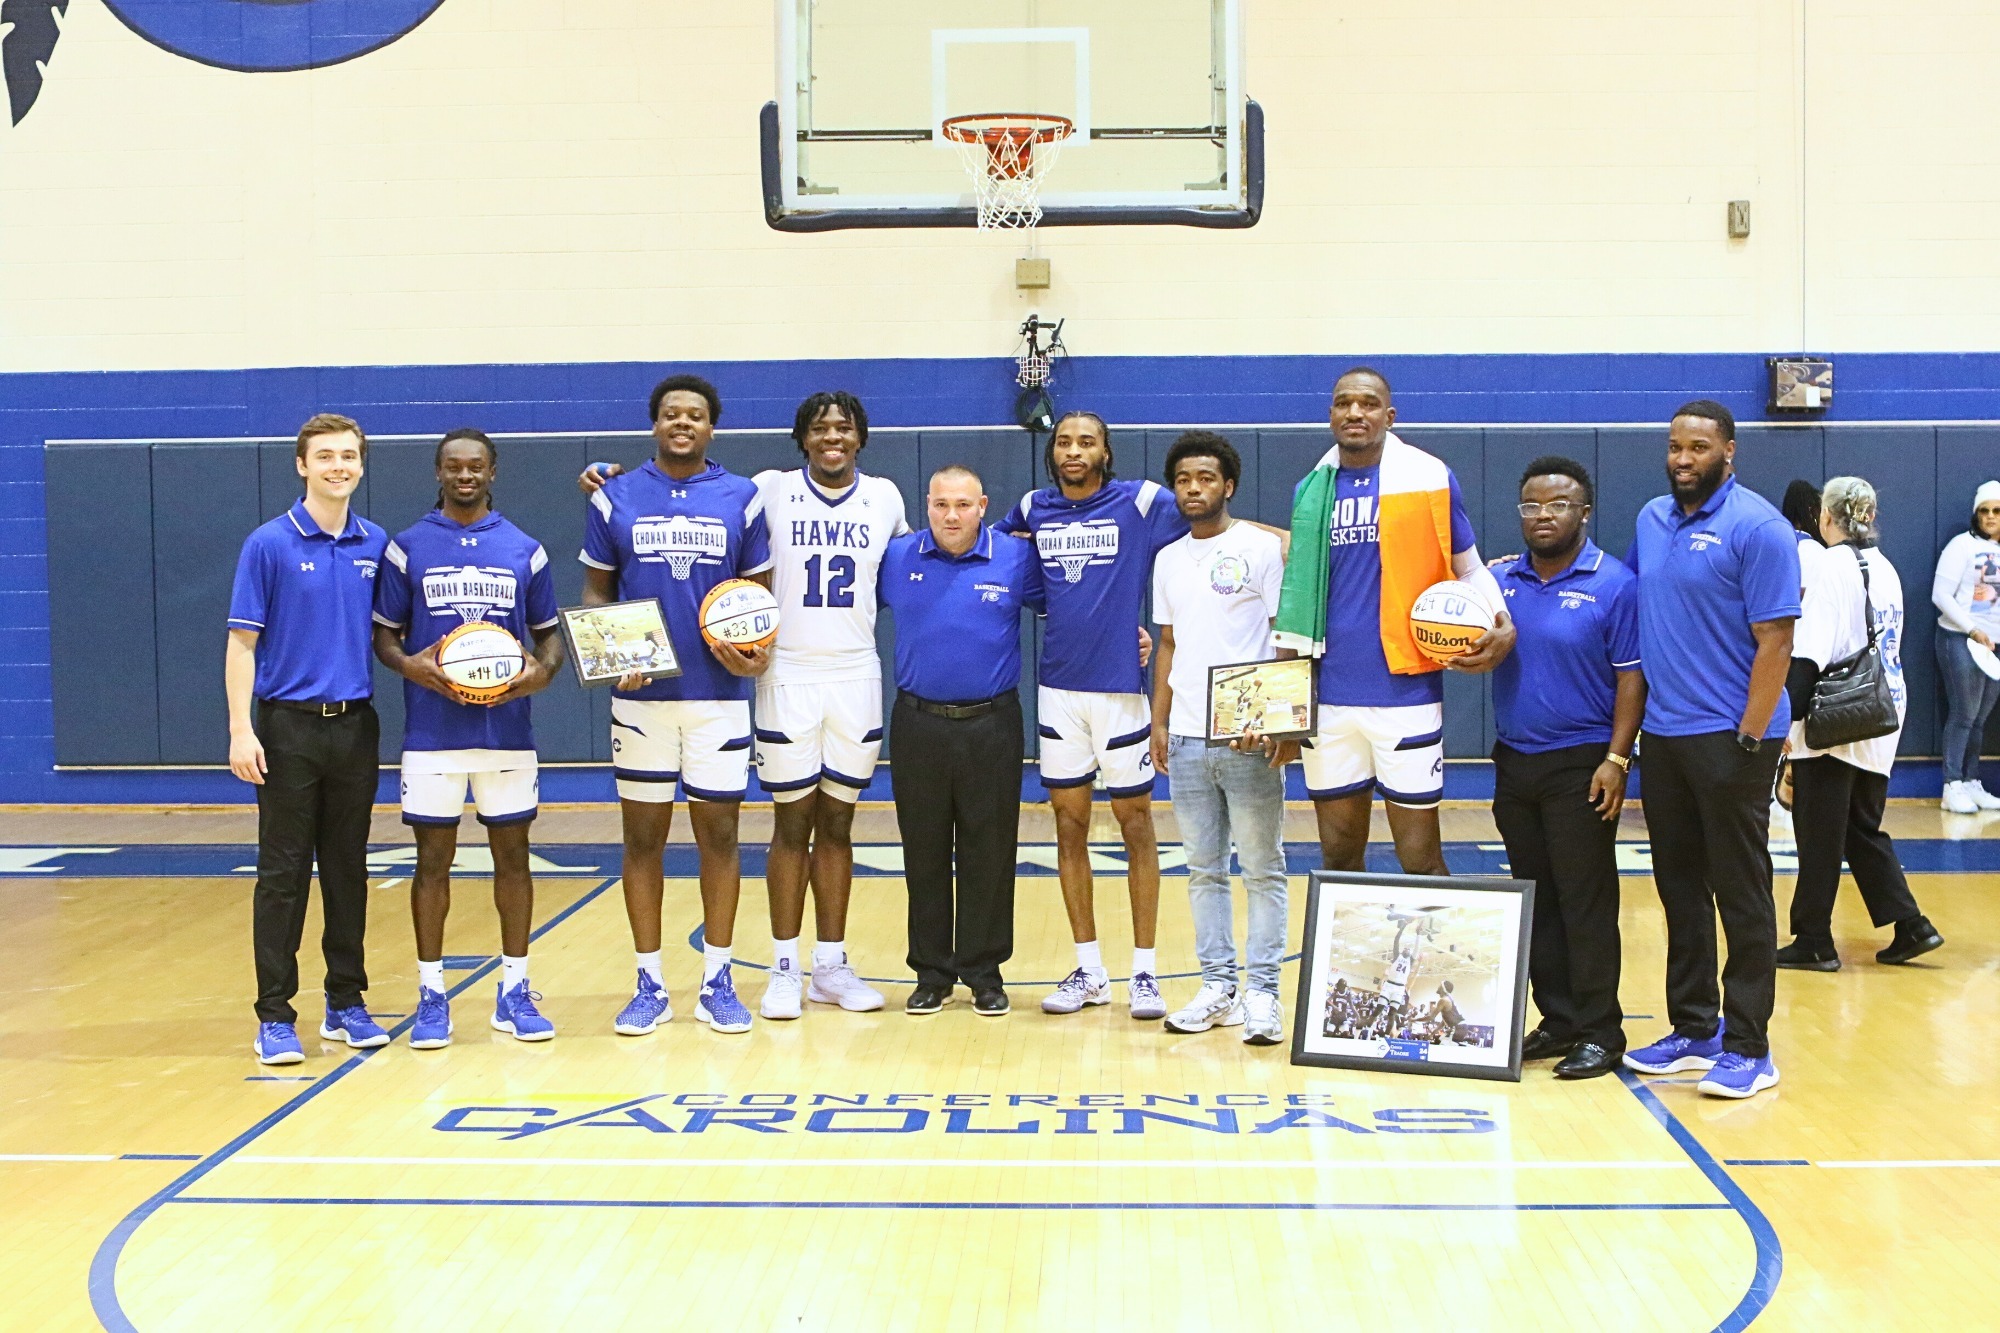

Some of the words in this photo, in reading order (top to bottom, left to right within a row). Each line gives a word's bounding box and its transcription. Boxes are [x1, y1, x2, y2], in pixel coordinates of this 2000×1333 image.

[635, 531, 667, 546] CHOWAN
[672, 531, 724, 548] BASKETBALL
[791, 520, 870, 549] HAWKS
[1067, 533, 1116, 549] BASKETBALL
[426, 583, 458, 599] CHOWAN
[463, 582, 514, 600] BASKETBALL
[803, 554, 856, 608] 12
[1443, 597, 1467, 617] CU
[723, 620, 748, 639] #33
[754, 613, 771, 634] CU
[1416, 626, 1470, 646] Wilson
[467, 666, 491, 680] #14
[495, 660, 512, 679] CU
[1395, 963, 1407, 974] 24
[672, 1093, 1335, 1106] CONFERENCE
[432, 1094, 1500, 1141] CAROLINAS
